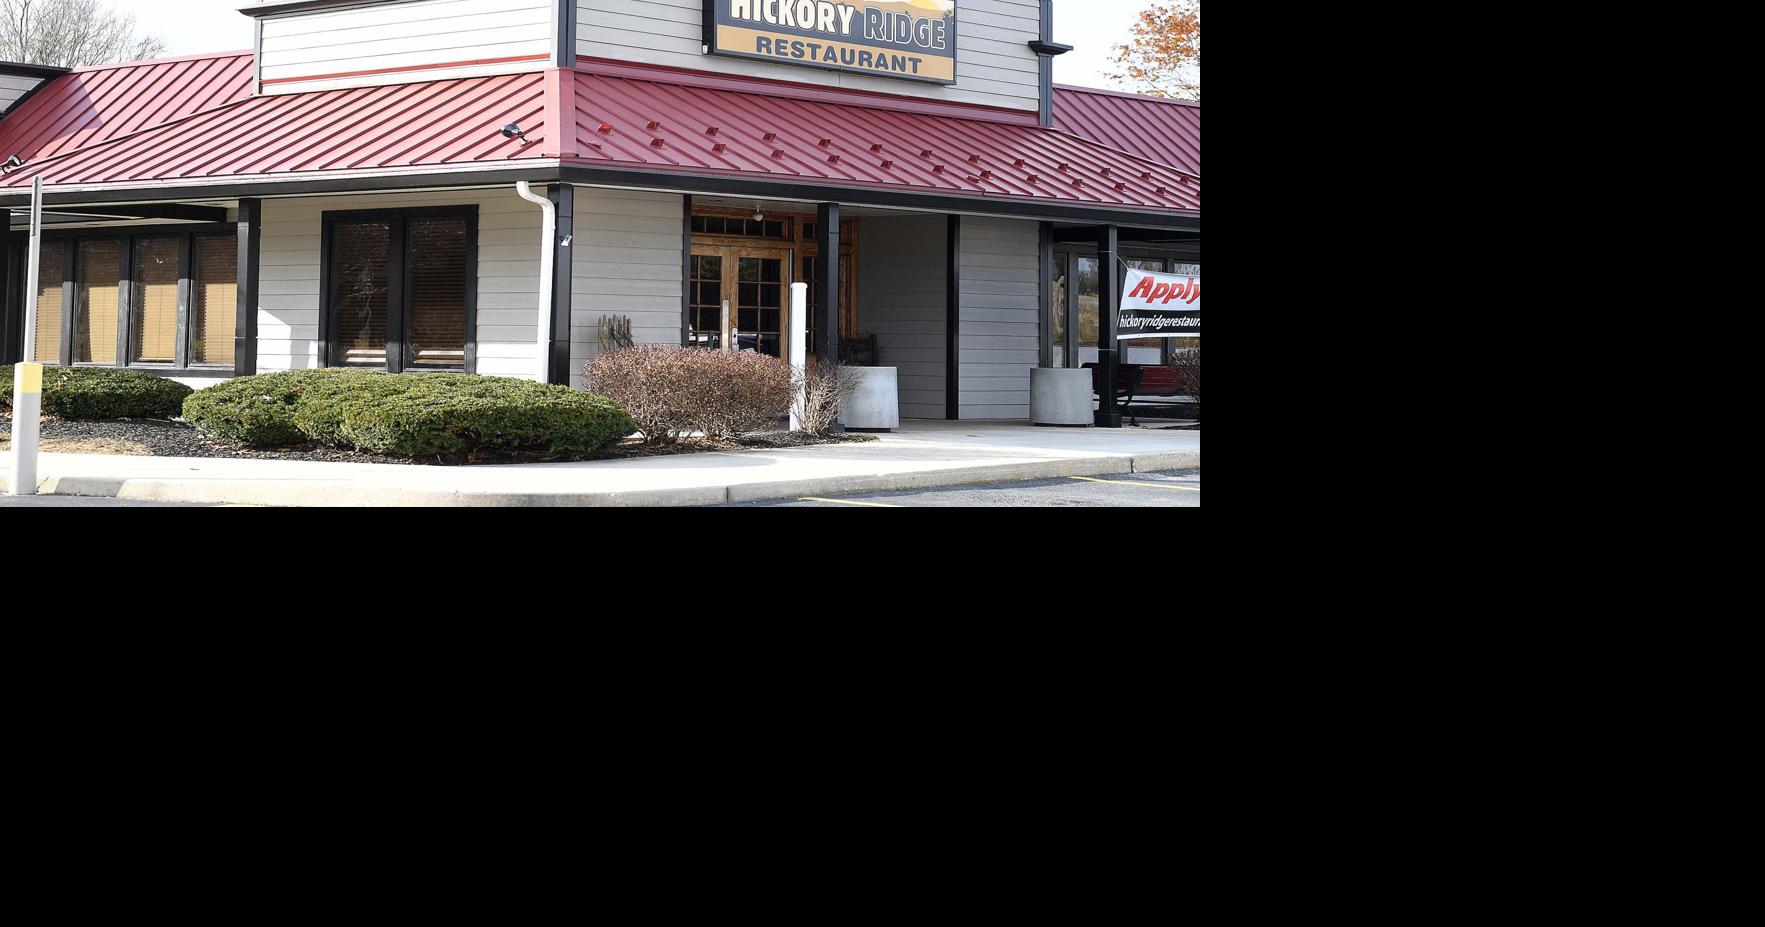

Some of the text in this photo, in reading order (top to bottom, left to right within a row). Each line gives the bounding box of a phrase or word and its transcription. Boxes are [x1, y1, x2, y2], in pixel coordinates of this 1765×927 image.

[730, 0, 946, 50] HICKORY RIDGE
[756, 36, 922, 74] RESTAURANT
[1128, 276, 1200, 305] Apply
